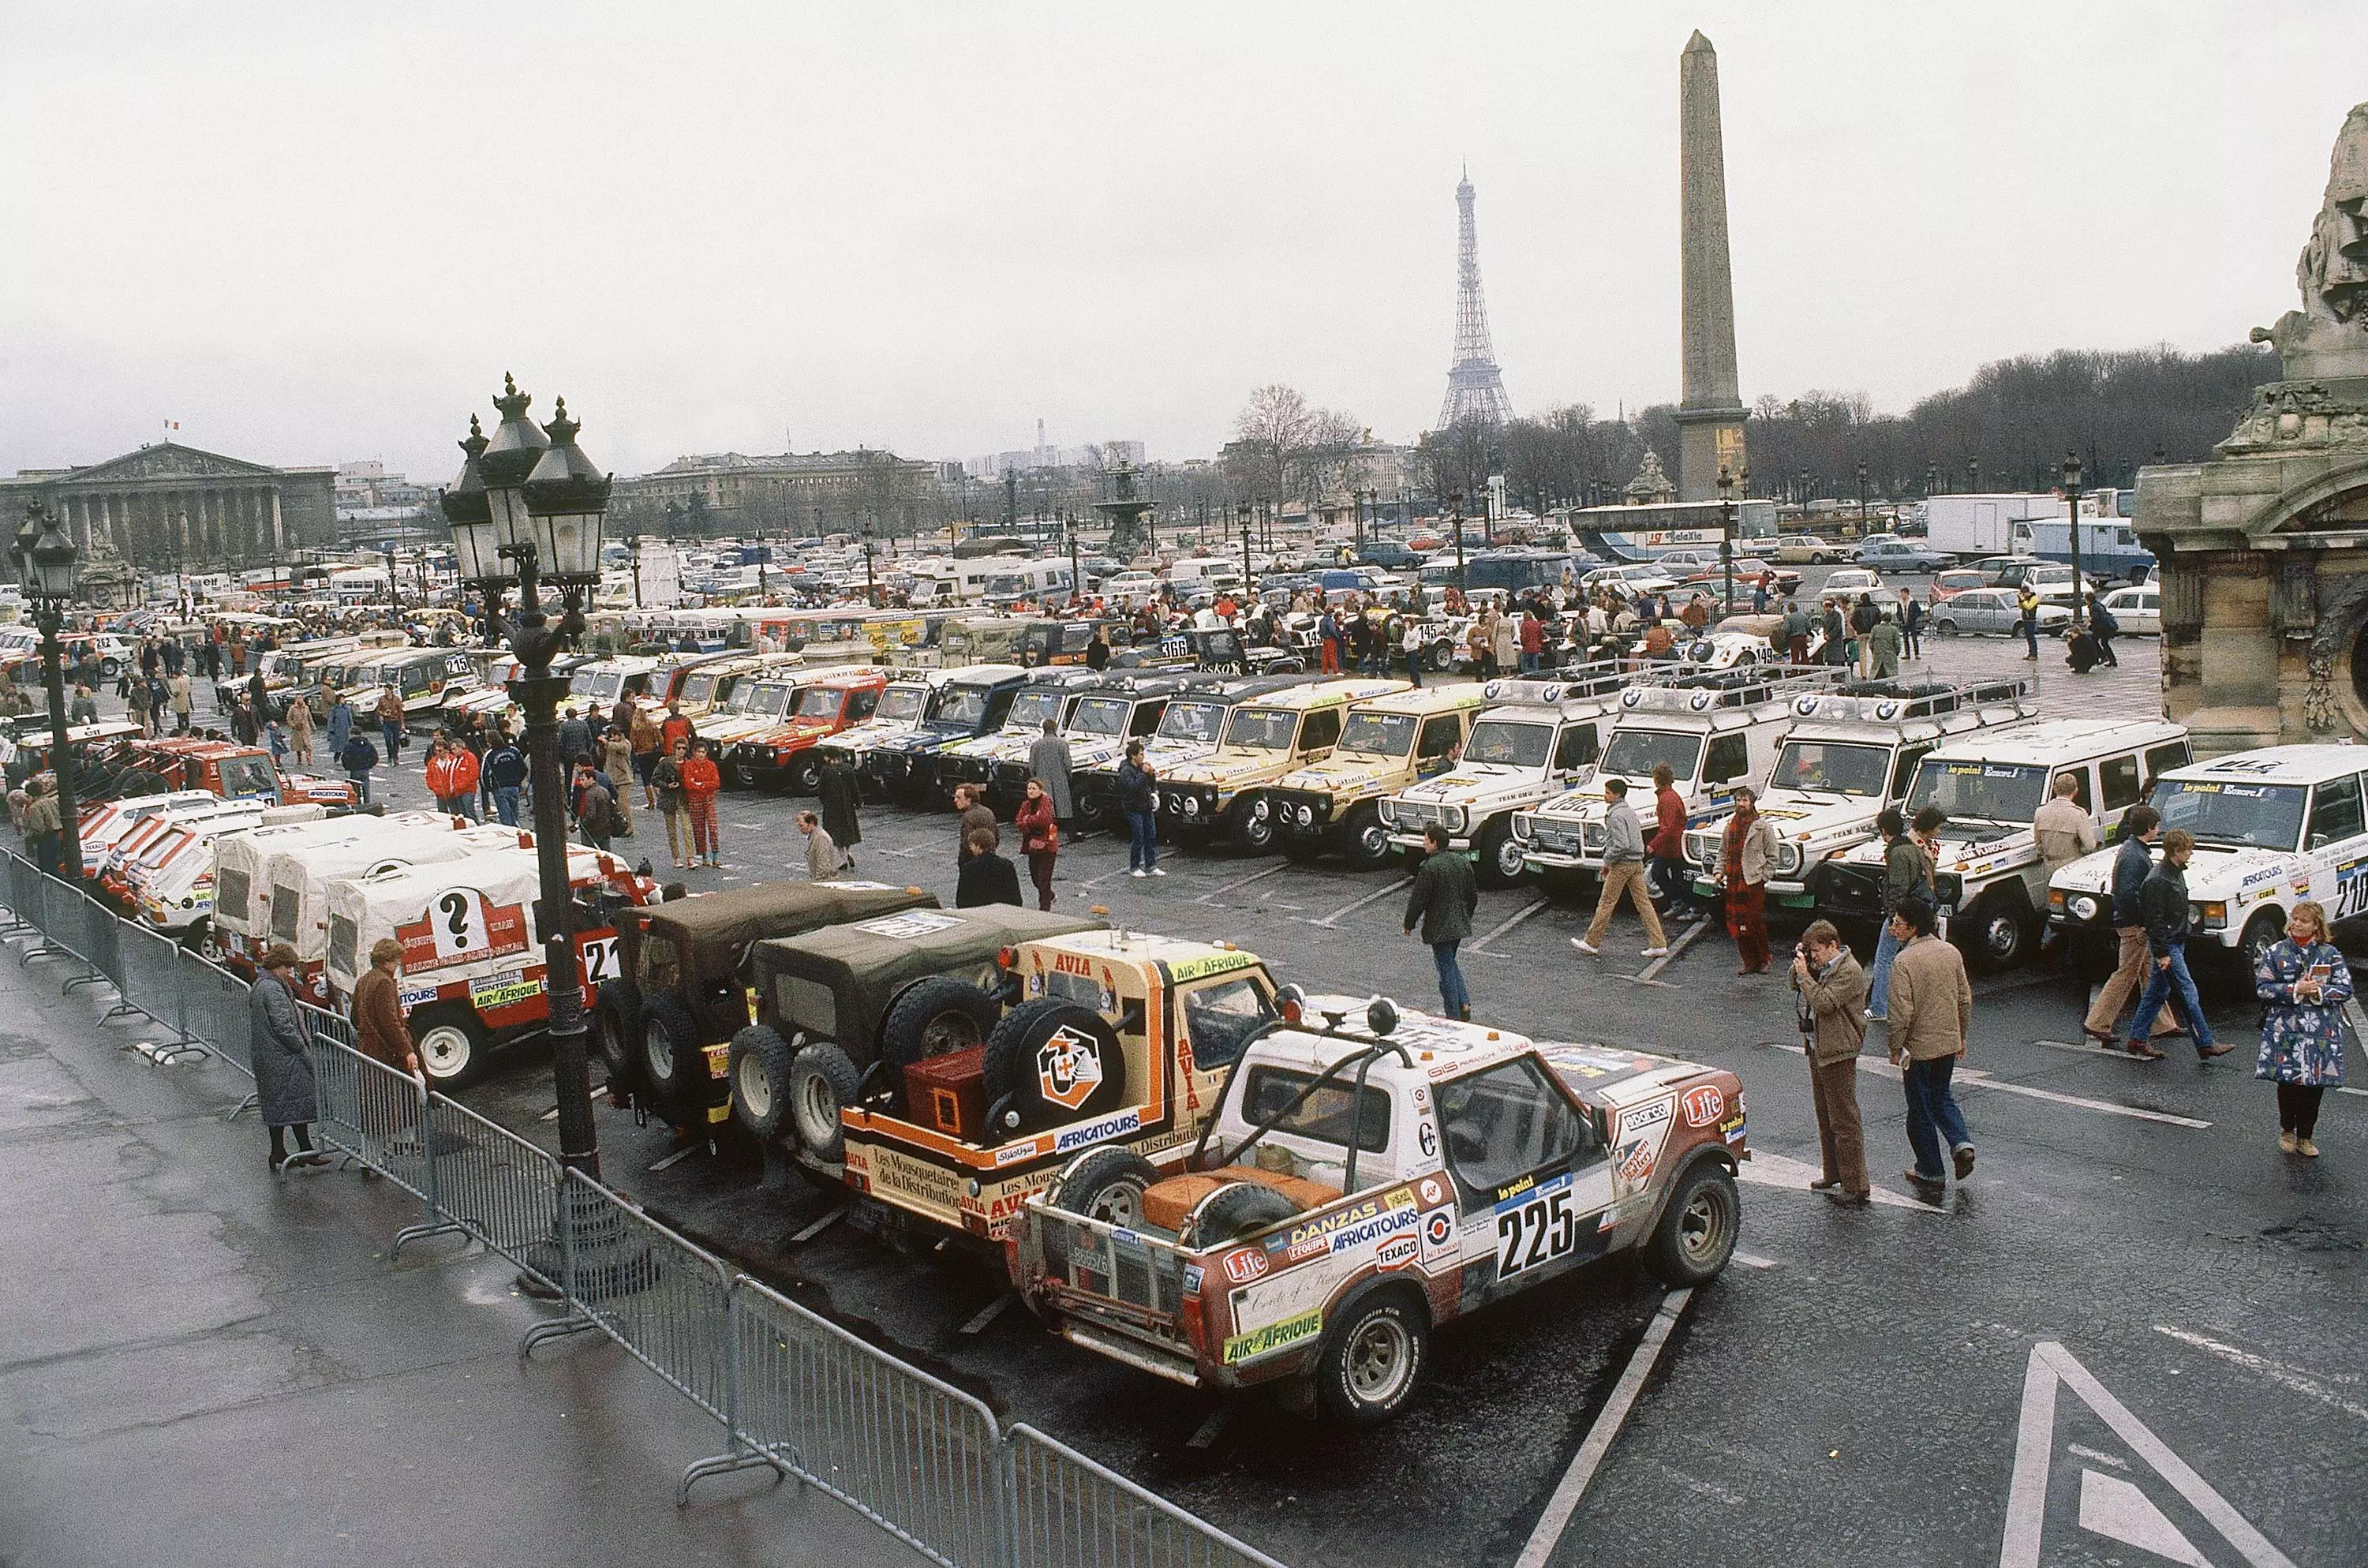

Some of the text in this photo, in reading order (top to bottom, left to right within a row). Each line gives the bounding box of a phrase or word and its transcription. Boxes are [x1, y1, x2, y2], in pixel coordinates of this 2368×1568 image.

[203, 577, 219, 586] elf
[95, 638, 111, 648] 262
[1420, 624, 1436, 640] 145
[1162, 639, 1187, 658] 366
[1756, 647, 1773, 664] 149
[446, 657, 468, 675] 215
[2193, 784, 2220, 794] point
[1831, 829, 1853, 840] TEAM
[2242, 864, 2283, 888] AFRICATOURS
[1054, 953, 1091, 977] AVIA
[1177, 953, 1250, 981] AIR AFRIQUE
[477, 993, 495, 1006] AIR
[499, 983, 538, 1003] AFRIQUE
[1177, 1038, 1200, 1112] AVIA
[1684, 1091, 1722, 1125] Life
[1057, 1113, 1139, 1151] AFRICATOURS
[846, 1151, 868, 1169] AVIA
[874, 1148, 960, 1192] Les Mousquetaires
[879, 1169, 960, 1209] de la Distribution
[1001, 1181, 1020, 1196] Les
[1498, 1174, 1535, 1201] le point
[960, 1195, 986, 1217] AVIA
[1290, 1201, 1379, 1245] DANZAS
[1331, 1207, 1419, 1253] AFRICATOURS
[1498, 1188, 1573, 1280] 225
[1378, 1240, 1417, 1263] TEXACO
[1227, 1250, 1265, 1280] Life
[1227, 1337, 1254, 1362] AIR
[1262, 1314, 1320, 1349] AFRIQUE
